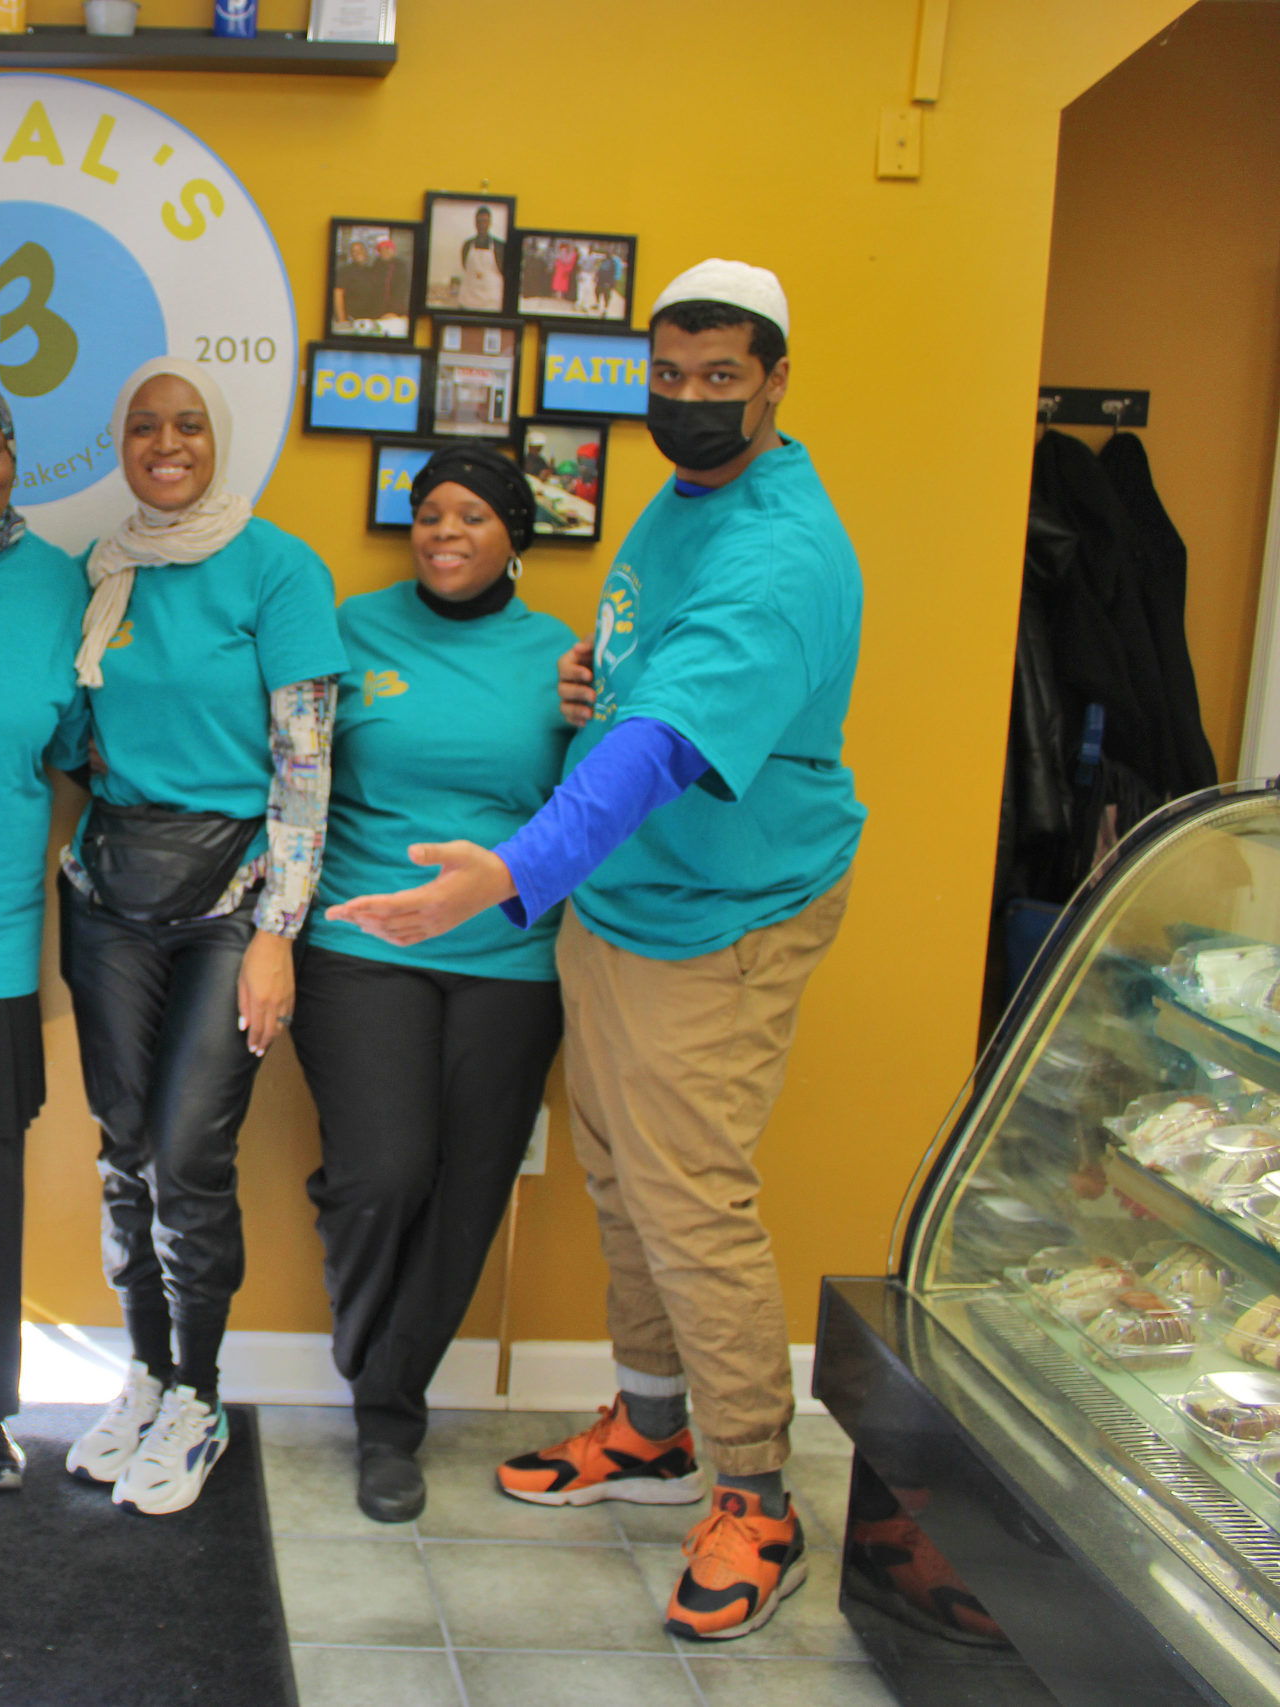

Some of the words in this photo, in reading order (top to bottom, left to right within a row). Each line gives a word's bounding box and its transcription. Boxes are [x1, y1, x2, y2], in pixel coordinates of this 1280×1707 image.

[195, 336, 276, 364] 2010
[547, 355, 648, 384] FAITH
[316, 369, 418, 404] FOOD
